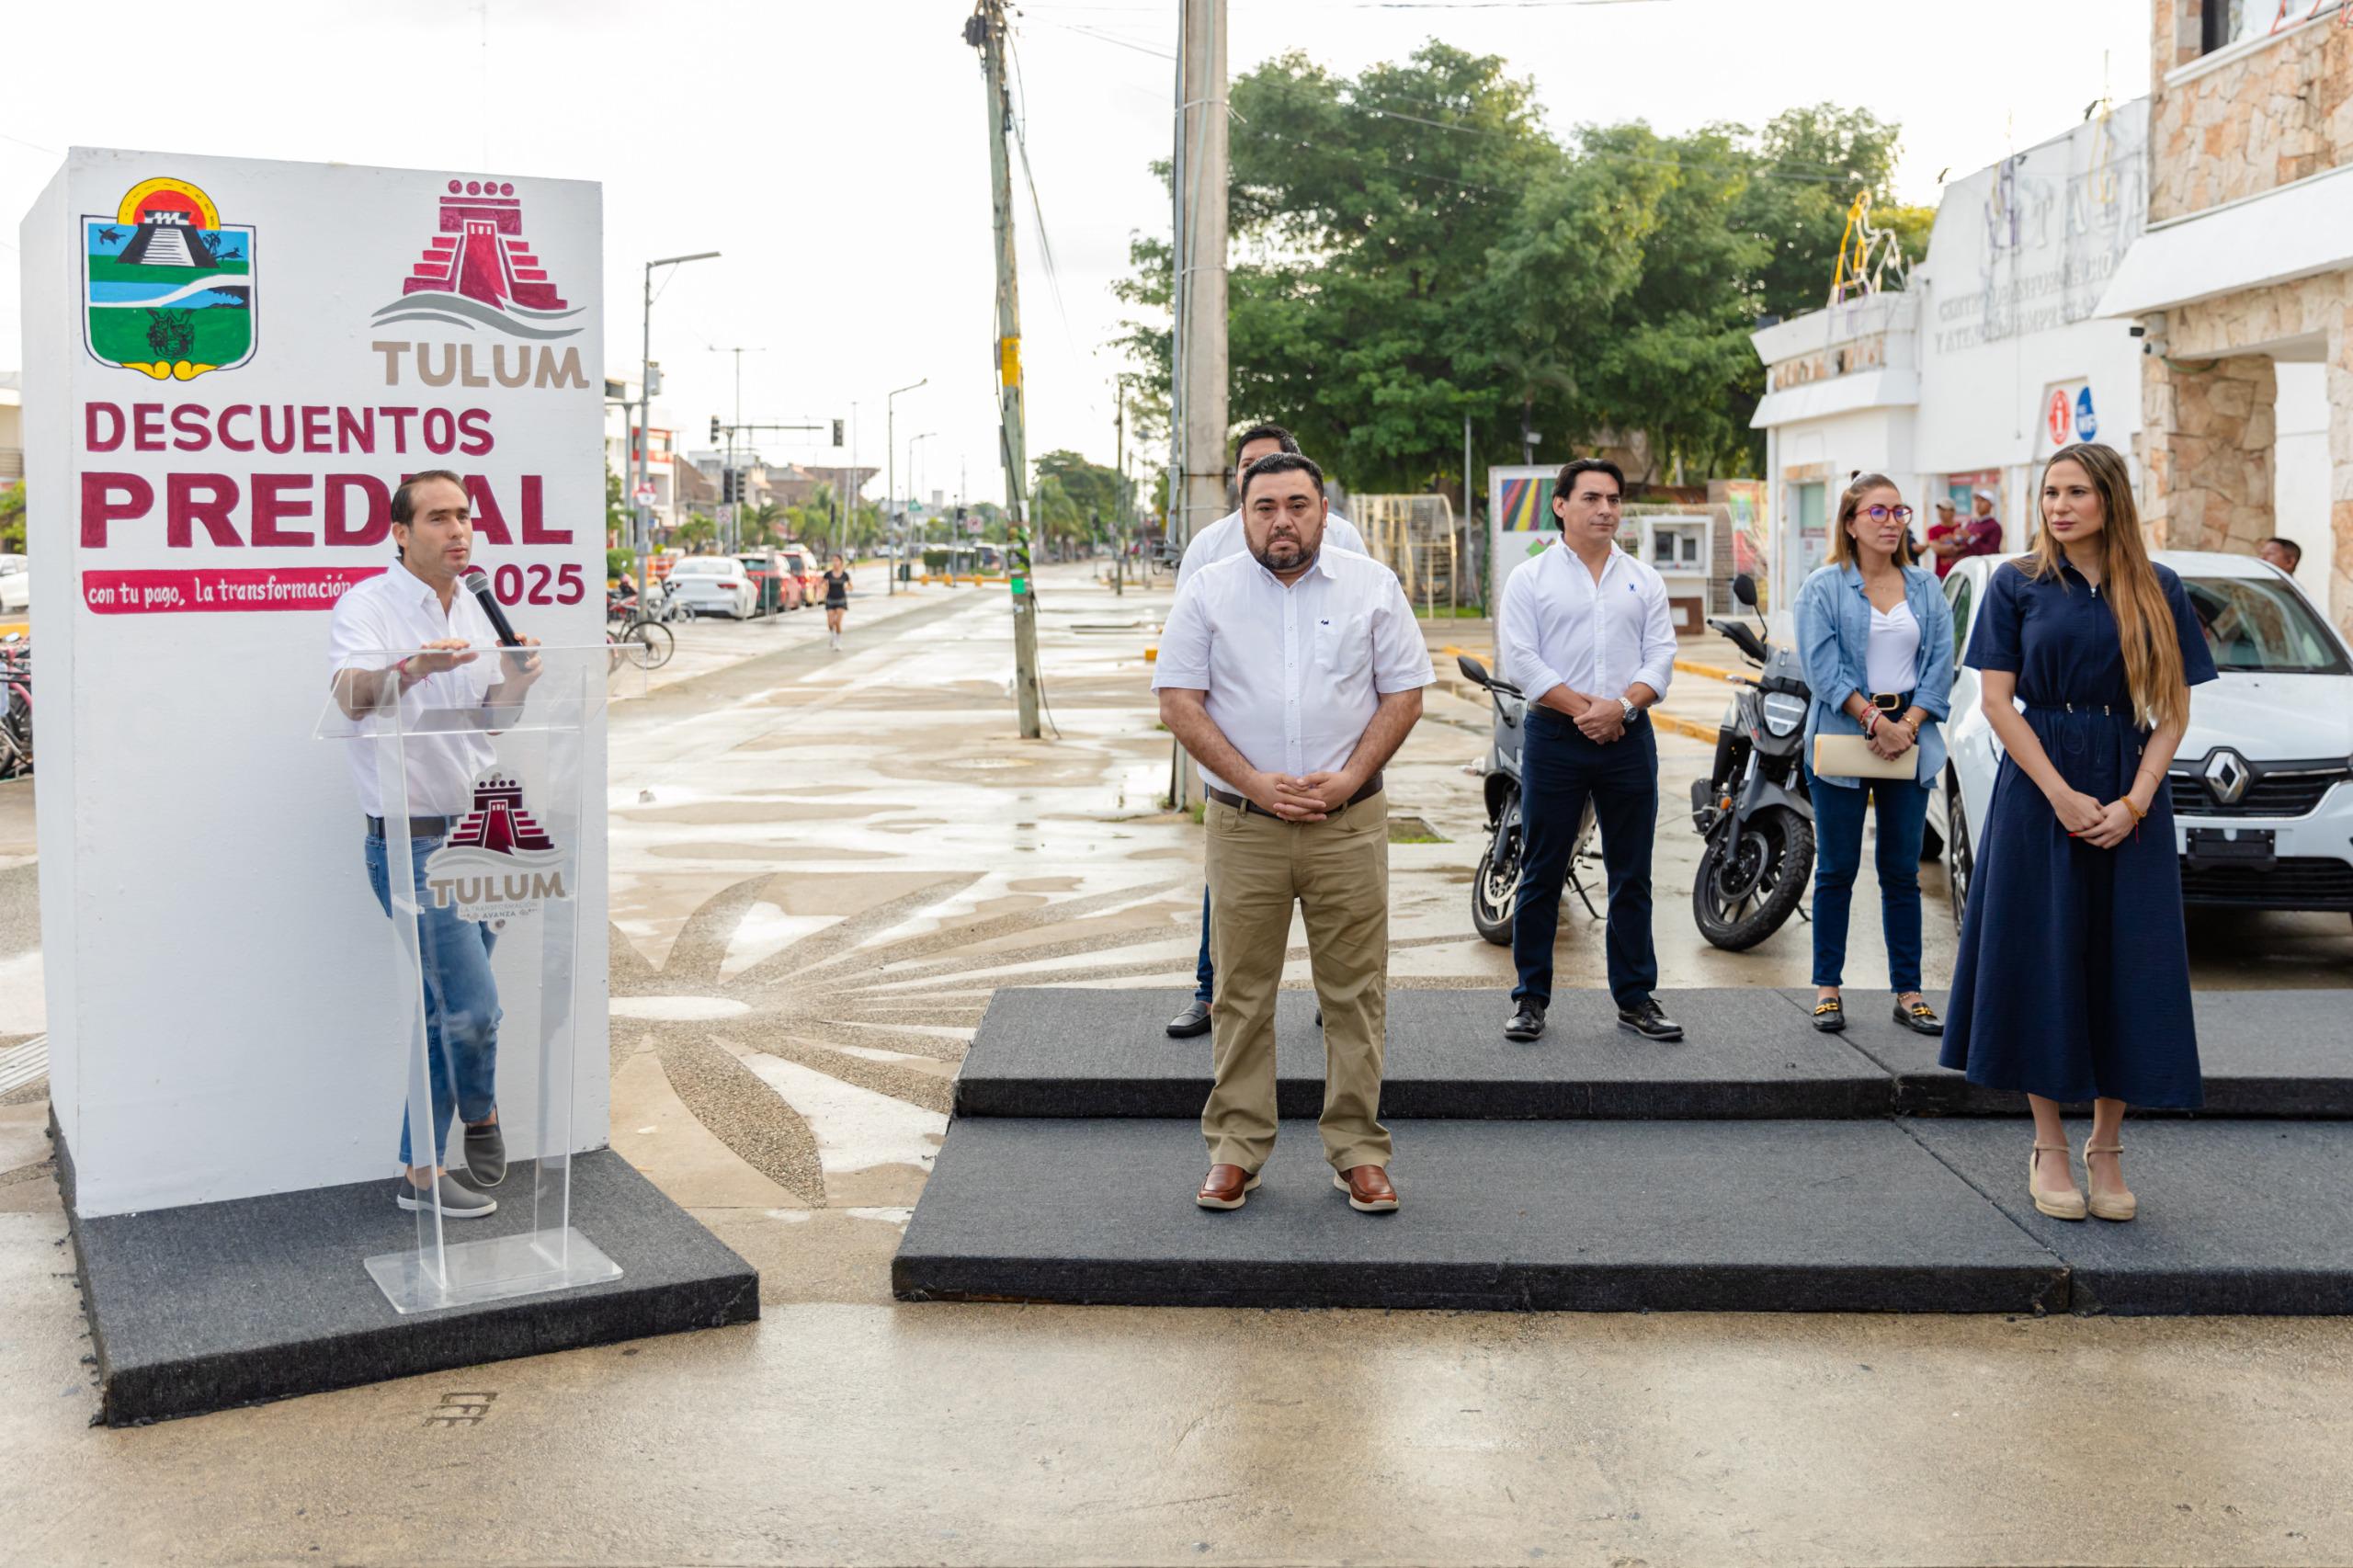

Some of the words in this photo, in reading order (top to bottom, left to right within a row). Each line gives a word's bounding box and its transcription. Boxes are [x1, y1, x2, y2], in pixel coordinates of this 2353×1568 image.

[371, 341, 589, 390] TULUM
[85, 402, 494, 457] DESCUENTOS
[80, 472, 574, 549] PREDAL
[88, 587, 115, 604] con
[119, 582, 139, 604] tu
[144, 586, 186, 608] pago,
[194, 576, 214, 603] la
[217, 574, 351, 601] transformación
[430, 872, 565, 906] TULUM
[483, 911, 517, 919] AVANZA
